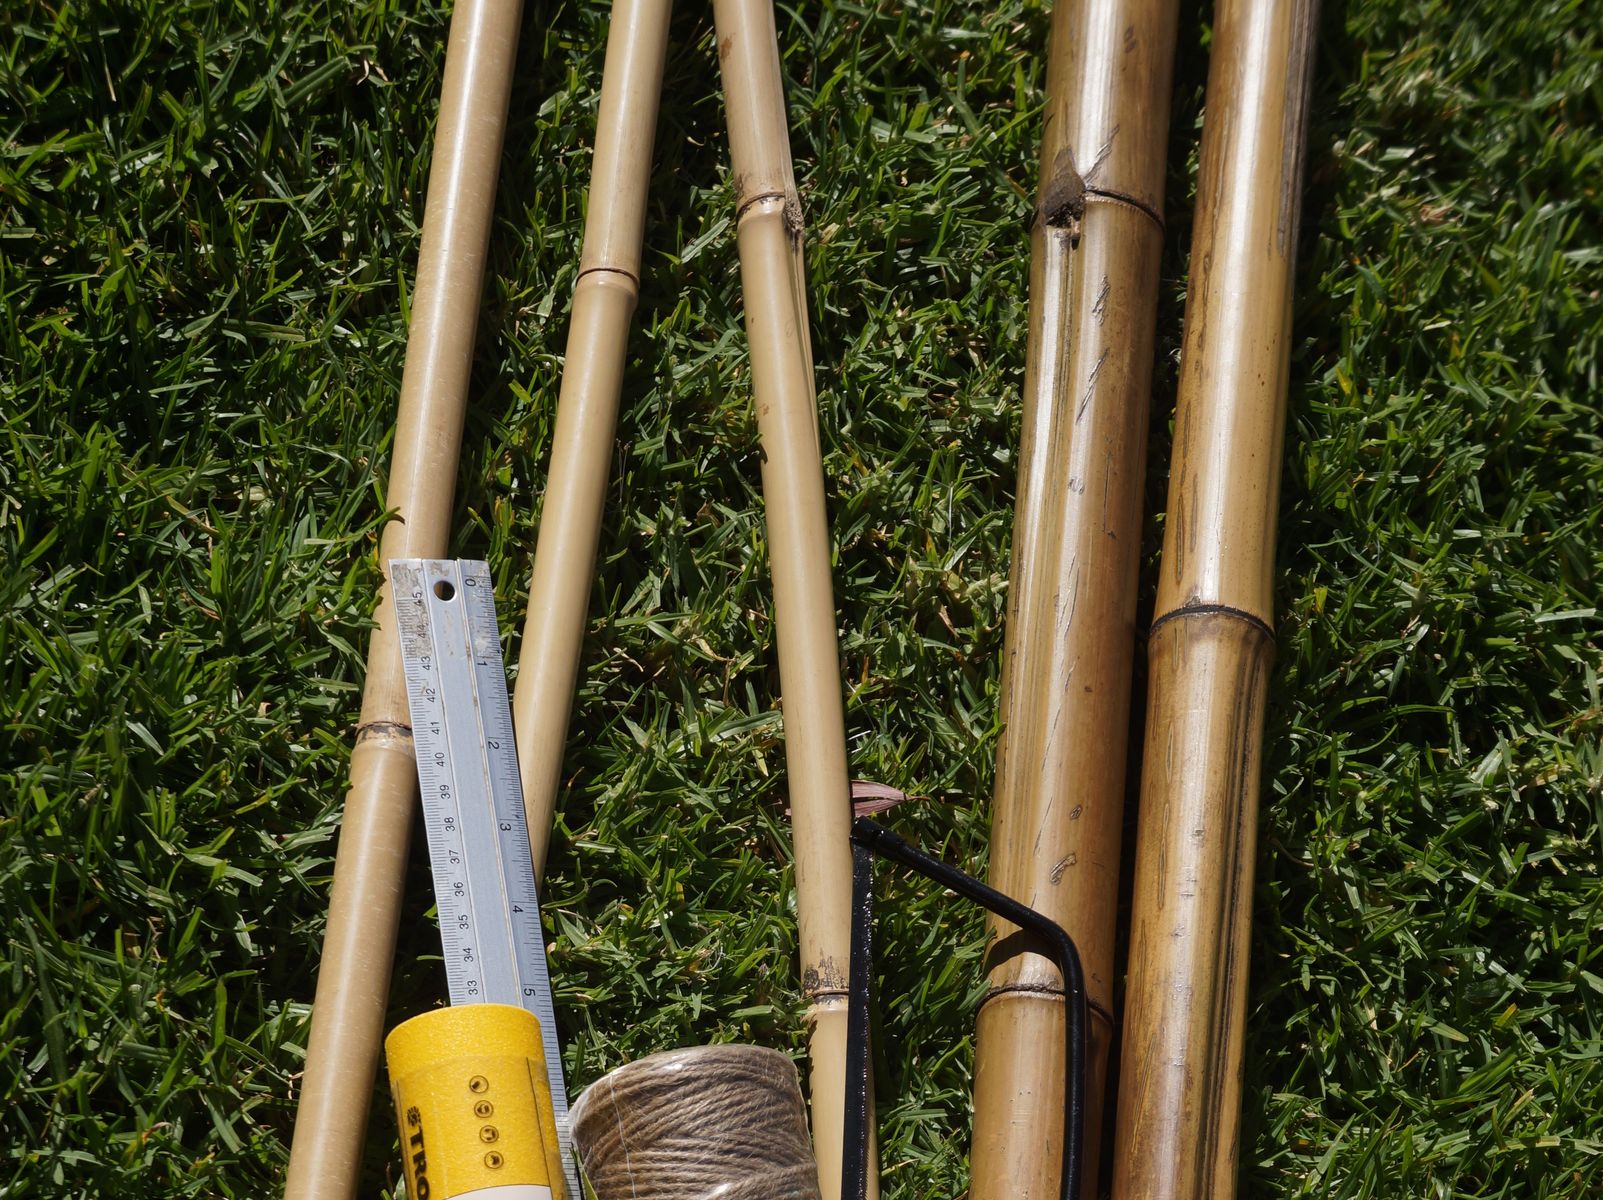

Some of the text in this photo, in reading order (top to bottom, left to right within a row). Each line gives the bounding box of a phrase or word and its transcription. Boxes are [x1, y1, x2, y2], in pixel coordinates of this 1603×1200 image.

[412, 592, 422, 607] 45
[422, 655, 431, 670] 43
[427, 688, 436, 702] 42
[432, 721, 440, 735] 41
[437, 753, 445, 767] 40
[440, 785, 450, 799] 39
[444, 817, 455, 832] 38
[449, 850, 460, 864] 37
[454, 882, 464, 896] 36
[459, 914, 468, 929] 35
[463, 948, 473, 962] 34
[468, 980, 478, 995] 33
